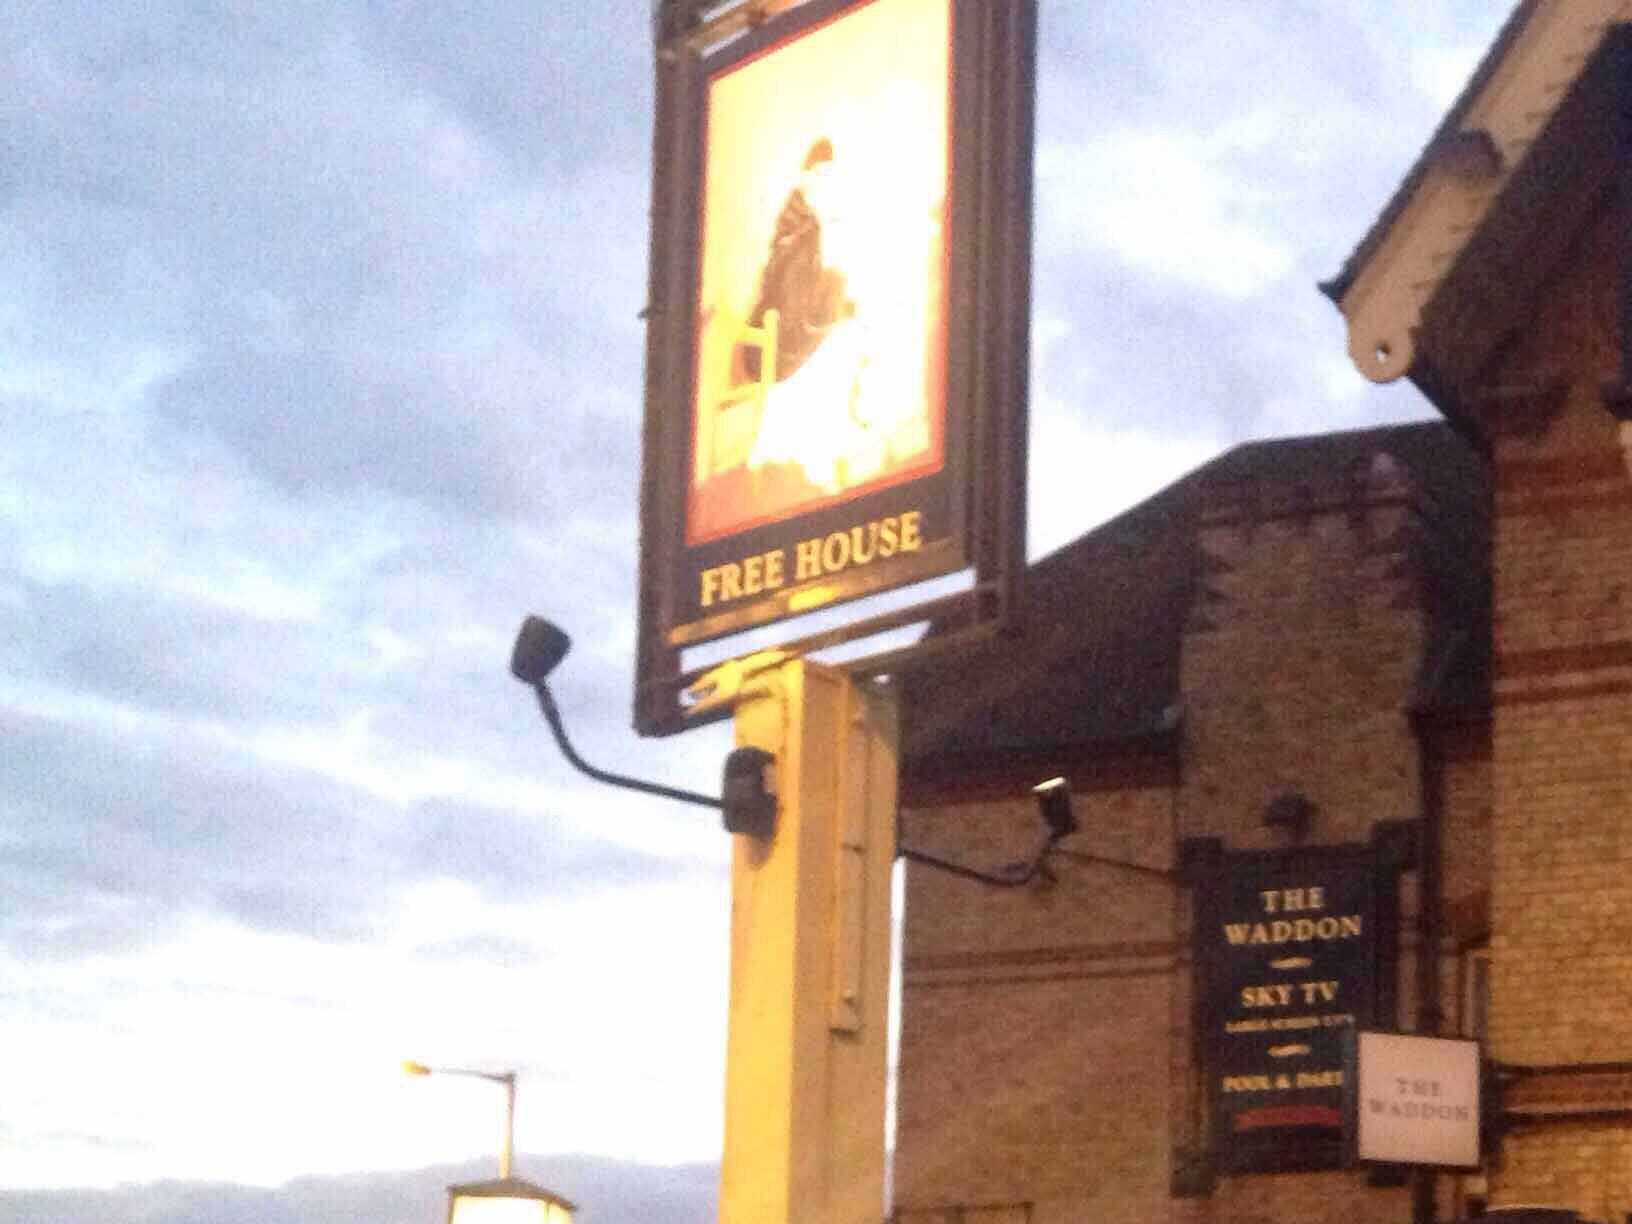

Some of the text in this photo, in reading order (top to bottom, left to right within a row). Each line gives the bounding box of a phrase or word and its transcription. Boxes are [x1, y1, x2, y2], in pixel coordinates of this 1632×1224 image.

[700, 511, 922, 606] FREE HOUSE
[1260, 887, 1325, 912] THE
[1224, 915, 1361, 944] WADDON
[1241, 980, 1339, 1007] SKY TV
[1396, 1078, 1440, 1097] THE
[1369, 1099, 1469, 1121] WADDON
